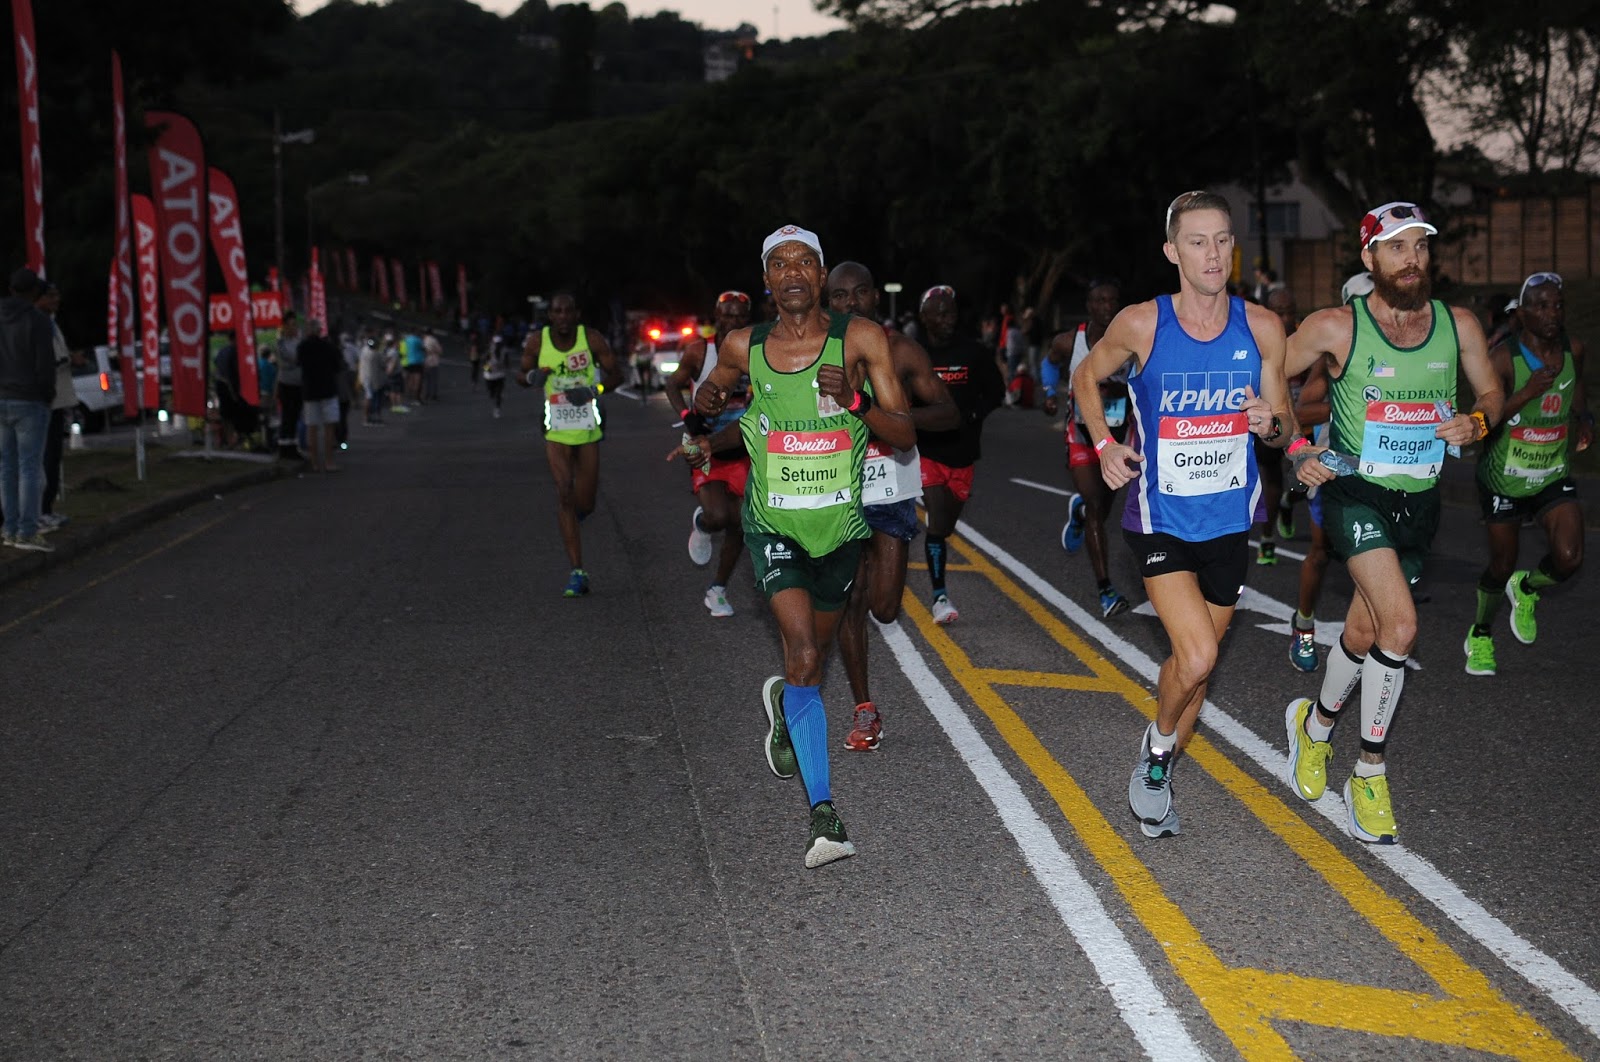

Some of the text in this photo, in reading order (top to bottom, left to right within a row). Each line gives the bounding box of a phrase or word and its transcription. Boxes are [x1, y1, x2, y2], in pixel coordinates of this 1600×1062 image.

[570, 353, 587, 369] 35
[1159, 387, 1247, 412] KPMG
[1541, 394, 1562, 413] 40
[556, 408, 589, 420] 39055
[1384, 404, 1436, 422] Bonitas
[774, 413, 851, 432] NEDBANK
[1176, 419, 1234, 438] Bonitas
[1522, 428, 1561, 442] Bonitas
[783, 434, 838, 453] Bonitas
[1378, 434, 1433, 456] Reagan
[1174, 450, 1233, 468] Grobler
[1392, 455, 1419, 464] 12224
[780, 466, 838, 482] Setumu
[1188, 469, 1219, 481] 26805
[1366, 464, 1374, 474] 0
[1428, 464, 1437, 476] A
[1166, 483, 1174, 493] 6
[1229, 475, 1240, 488] A
[796, 485, 825, 495] 17716
[835, 490, 846, 502] A
[885, 486, 894, 497] B
[771, 496, 784, 507] 17
